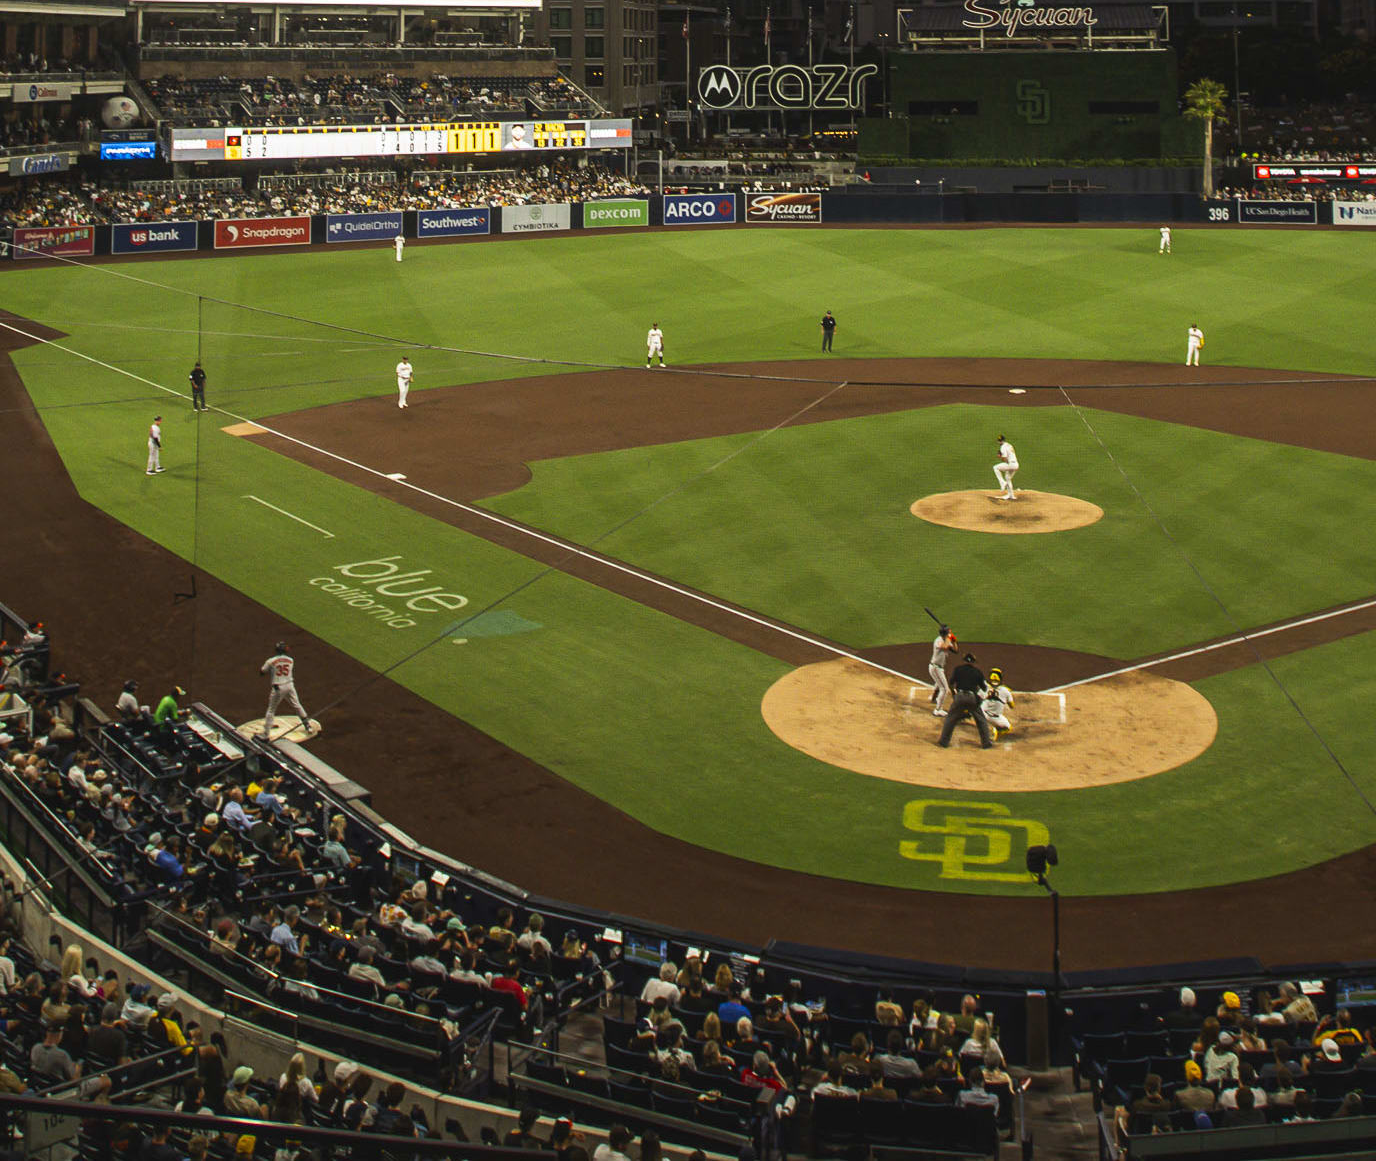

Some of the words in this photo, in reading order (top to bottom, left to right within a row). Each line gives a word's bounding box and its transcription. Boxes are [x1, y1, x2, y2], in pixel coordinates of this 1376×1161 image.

[744, 64, 878, 109] razr
[1270, 167, 1296, 176] TOYOTA
[666, 202, 716, 217] ARCO
[750, 196, 813, 220] Sycuan
[1208, 207, 1229, 221] 396
[345, 221, 399, 234] QuidelOrtho
[423, 216, 478, 229] Southwest
[132, 232, 147, 242] us
[149, 229, 179, 241] bank
[242, 227, 305, 239] Snapdragon
[333, 555, 469, 612] blue
[308, 577, 416, 629] california
[275, 664, 290, 677] 35
